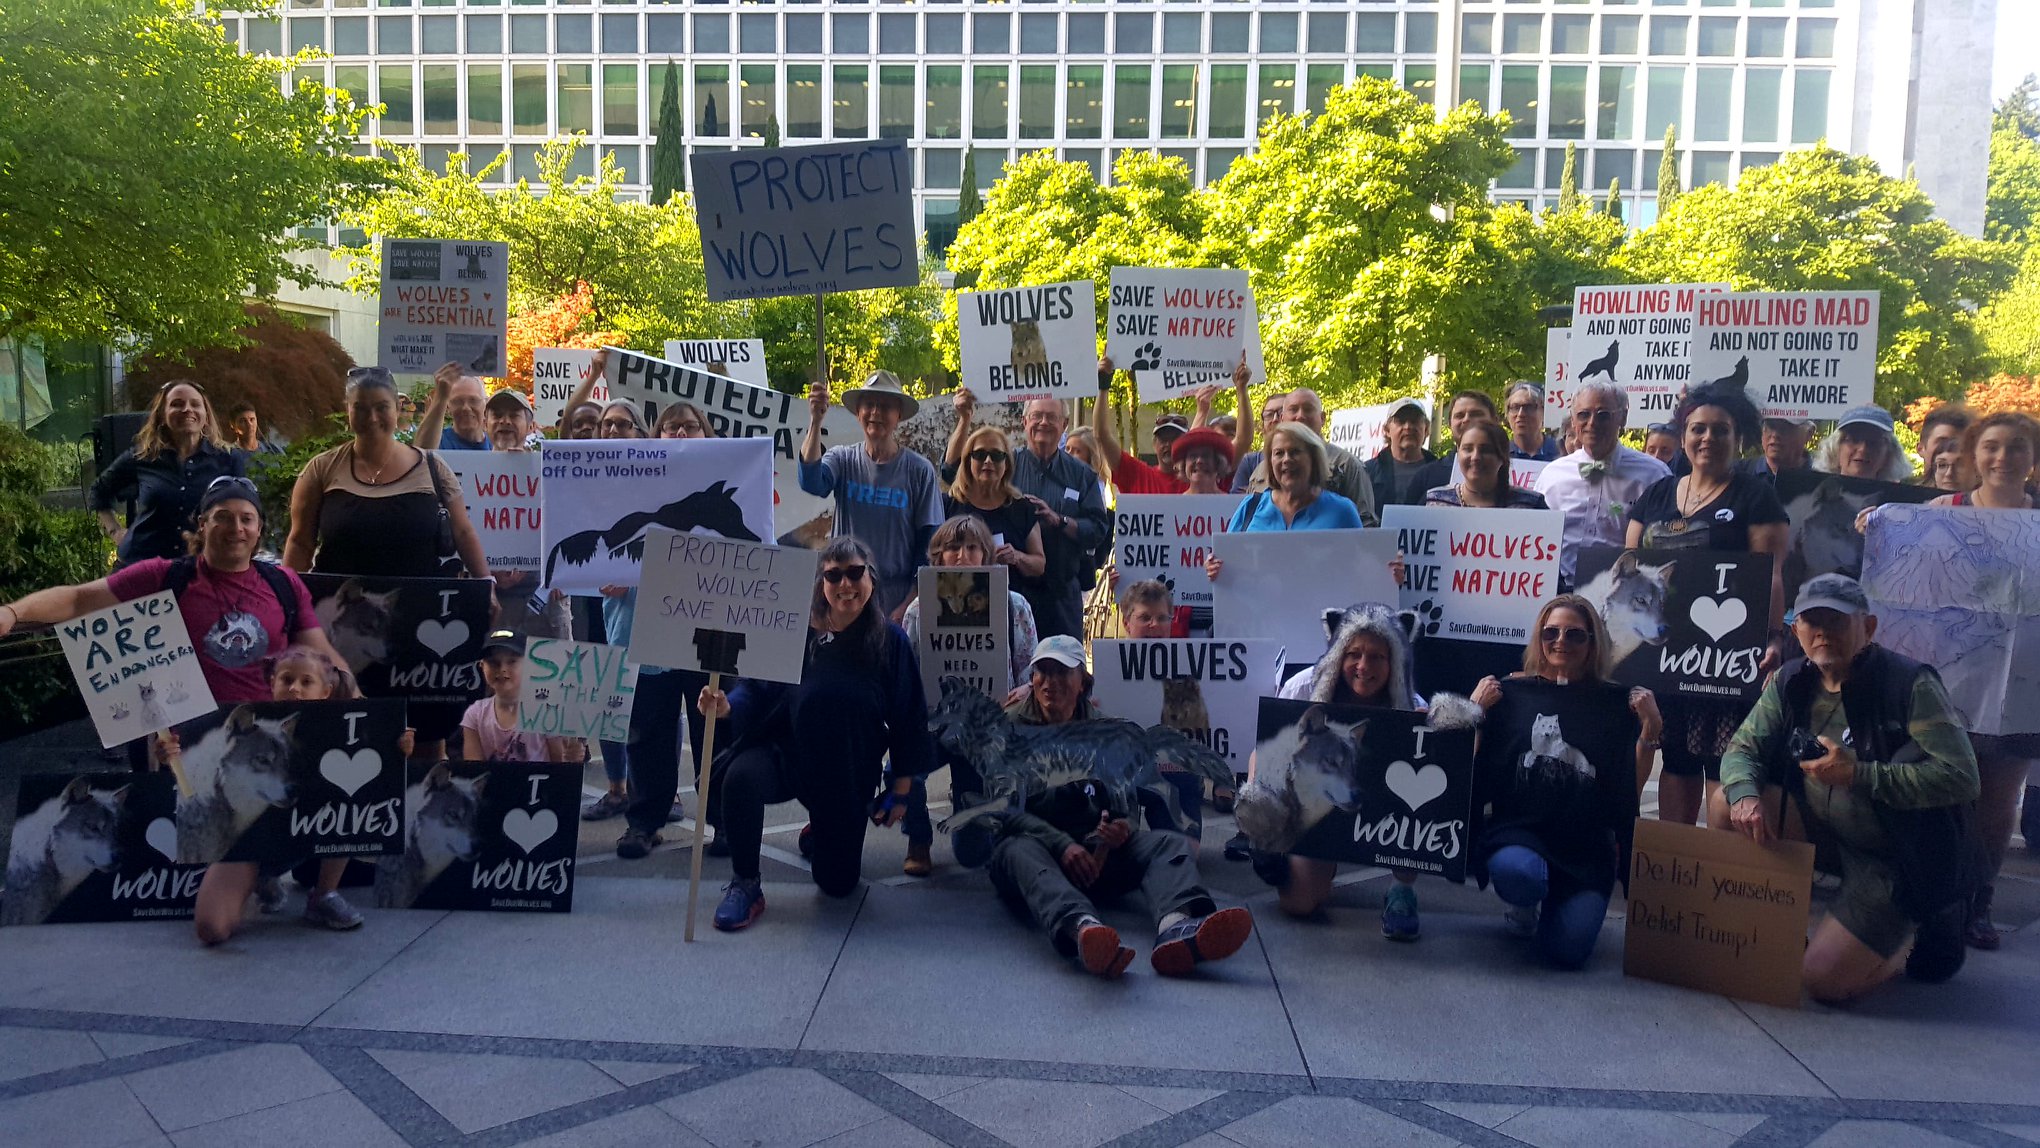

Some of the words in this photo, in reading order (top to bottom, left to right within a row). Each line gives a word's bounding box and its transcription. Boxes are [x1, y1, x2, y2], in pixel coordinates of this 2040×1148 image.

[730, 145, 901, 214] PROTECT
[455, 245, 493, 258] WOLVES
[709, 222, 903, 281] WOLVES
[397, 286, 470, 305] WOLVES
[977, 285, 1074, 327] WOLVES
[1112, 285, 1155, 308] SAVE
[1164, 287, 1244, 310] WOLVES:
[1579, 290, 1670, 314] HOWLING
[384, 307, 402, 318] ARE
[407, 305, 497, 327] ESSENTIAL
[1116, 314, 1159, 336] SAVE
[1167, 316, 1236, 339] NATURE
[1699, 298, 1807, 327] HOWLING
[1814, 298, 1871, 326] MAD
[1586, 319, 1615, 336] AND
[1618, 318, 1647, 335] NOT
[1649, 318, 1691, 334] GOING
[680, 341, 751, 364] WOLVES
[1645, 341, 1680, 358] TAKE
[1709, 332, 1743, 351] AND
[1747, 332, 1779, 351] NOT
[1783, 332, 1833, 351] GOING
[1838, 332, 1858, 351] TO
[536, 361, 571, 379] SAVE
[989, 360, 1068, 392] BELONG.
[1634, 364, 1691, 381] ANYMO
[1779, 358, 1821, 377] TAKE
[1825, 359, 1840, 378] IT
[1767, 384, 1849, 404] ANYMORE
[1332, 422, 1363, 442] SAVE
[542, 449, 582, 463] Keep
[586, 450, 622, 463] your
[627, 448, 667, 460] Paws
[475, 473, 540, 497] WOLV
[542, 466, 567, 478] Off
[571, 466, 600, 478] Our
[605, 464, 667, 477] Wolves!
[484, 507, 541, 530] NATU
[1118, 513, 1164, 537] SAVE
[668, 535, 781, 575] PROTECT
[1124, 544, 1170, 568] SAVE
[1398, 528, 1438, 555] AVE
[1450, 531, 1557, 561] WOLVES:
[697, 572, 781, 601] WOLVES
[1399, 564, 1441, 592] AVE
[1452, 569, 1545, 598] NATURE
[1715, 563, 1737, 594] I
[438, 589, 459, 617] I
[660, 595, 715, 620] SAVE
[726, 604, 800, 631] NATURE
[930, 633, 995, 651] WOLVES
[390, 660, 482, 691] WOLVES
[528, 640, 634, 693] SAVE
[944, 660, 978, 672] NEED
[1118, 642, 1247, 681] WOLVES
[1659, 643, 1762, 683] WOLVES
[560, 683, 600, 703] THE
[343, 711, 368, 746] I
[520, 702, 630, 740] WOLVES
[1412, 726, 1434, 759] I
[528, 774, 549, 805] I
[290, 798, 401, 837] WOLVES
[1353, 812, 1464, 859] WOLVES
[112, 868, 207, 901] WOLVE
[472, 857, 572, 895] WOLVES
[1632, 900, 1684, 935] Delist
[1692, 911, 1757, 958] Trump!
